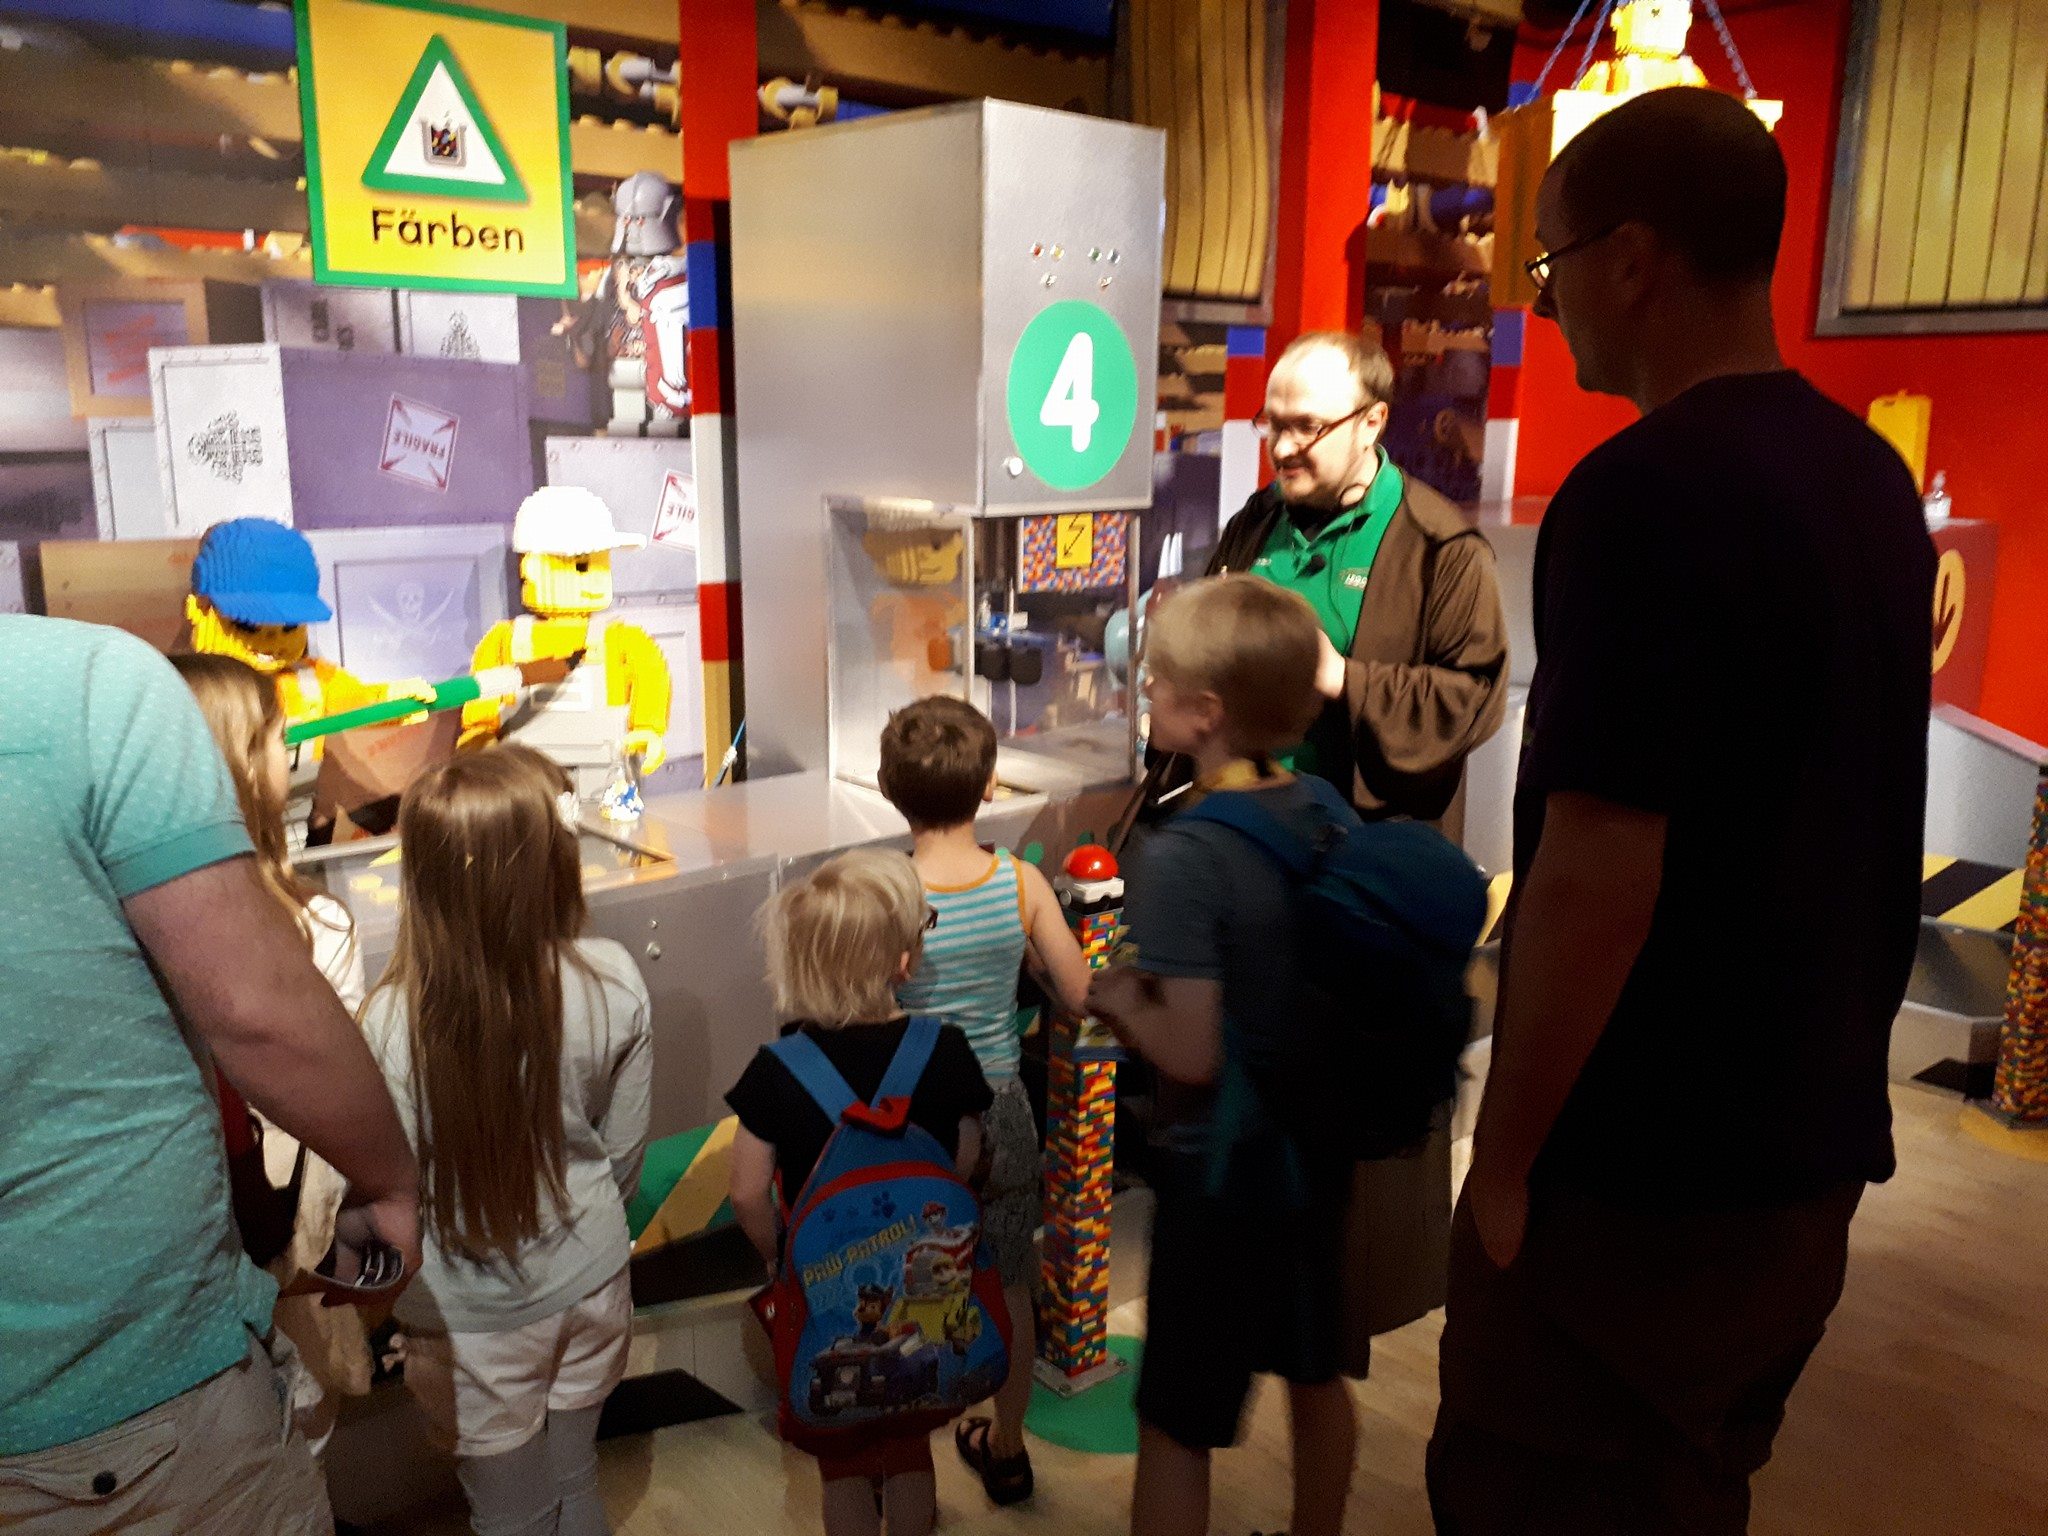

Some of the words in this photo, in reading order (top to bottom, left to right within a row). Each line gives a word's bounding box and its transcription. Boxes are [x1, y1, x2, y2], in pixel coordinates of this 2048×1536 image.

[373, 207, 524, 251] Färben
[1040, 332, 1099, 453] 4
[394, 430, 446, 458] FRAGILE
[803, 1254, 842, 1286] PAW
